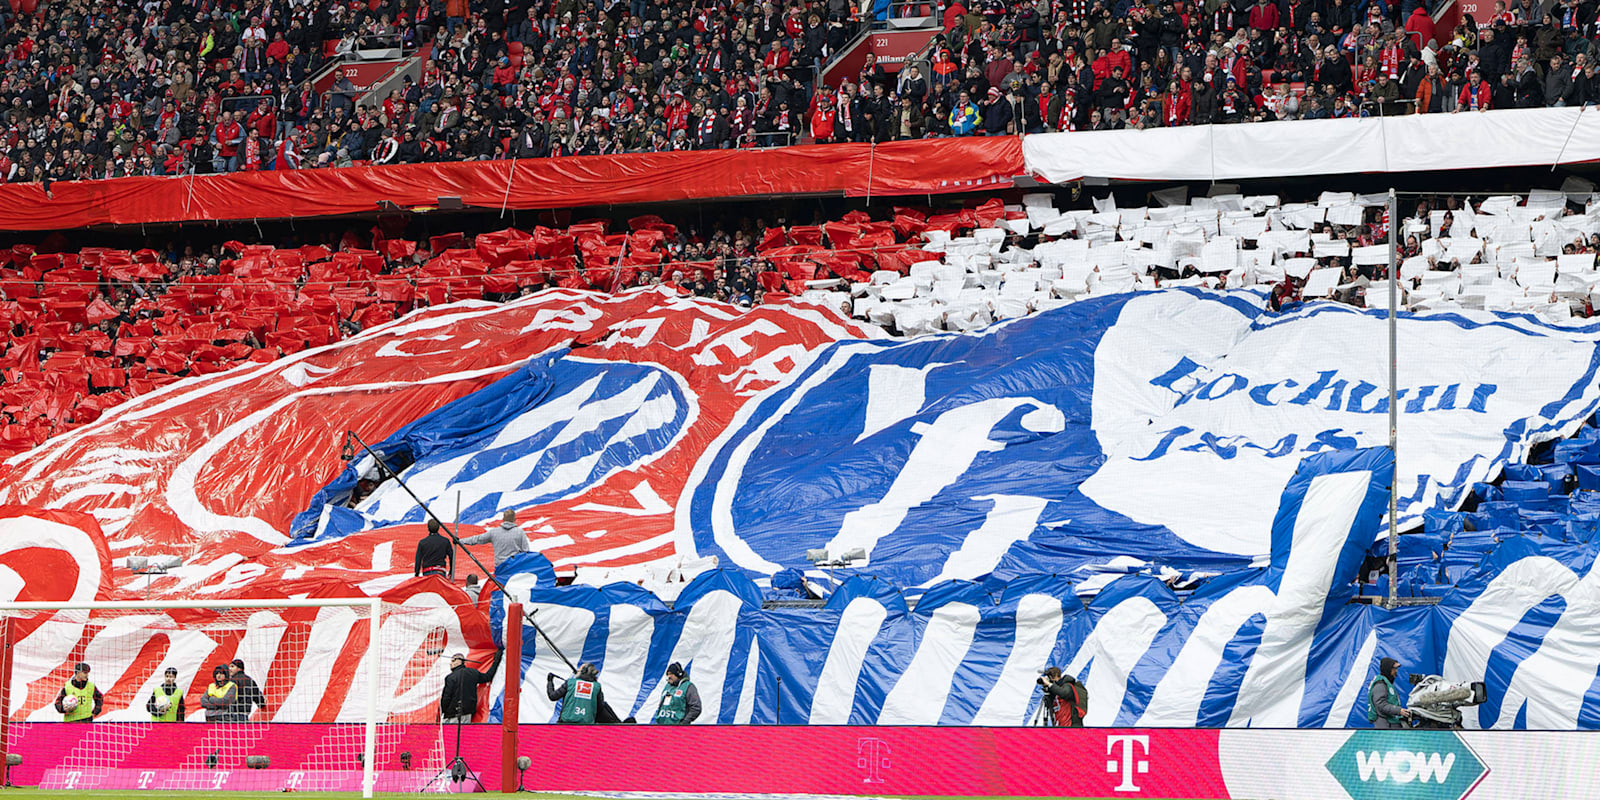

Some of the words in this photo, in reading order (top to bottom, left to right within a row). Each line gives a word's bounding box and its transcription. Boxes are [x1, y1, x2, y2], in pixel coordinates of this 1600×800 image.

[1462, 4, 1478, 12] 220
[876, 39, 888, 47] 221
[346, 69, 358, 77] 222
[574, 706, 586, 716] 34
[1106, 734, 1150, 792] T
[1355, 750, 1456, 785] WOW
